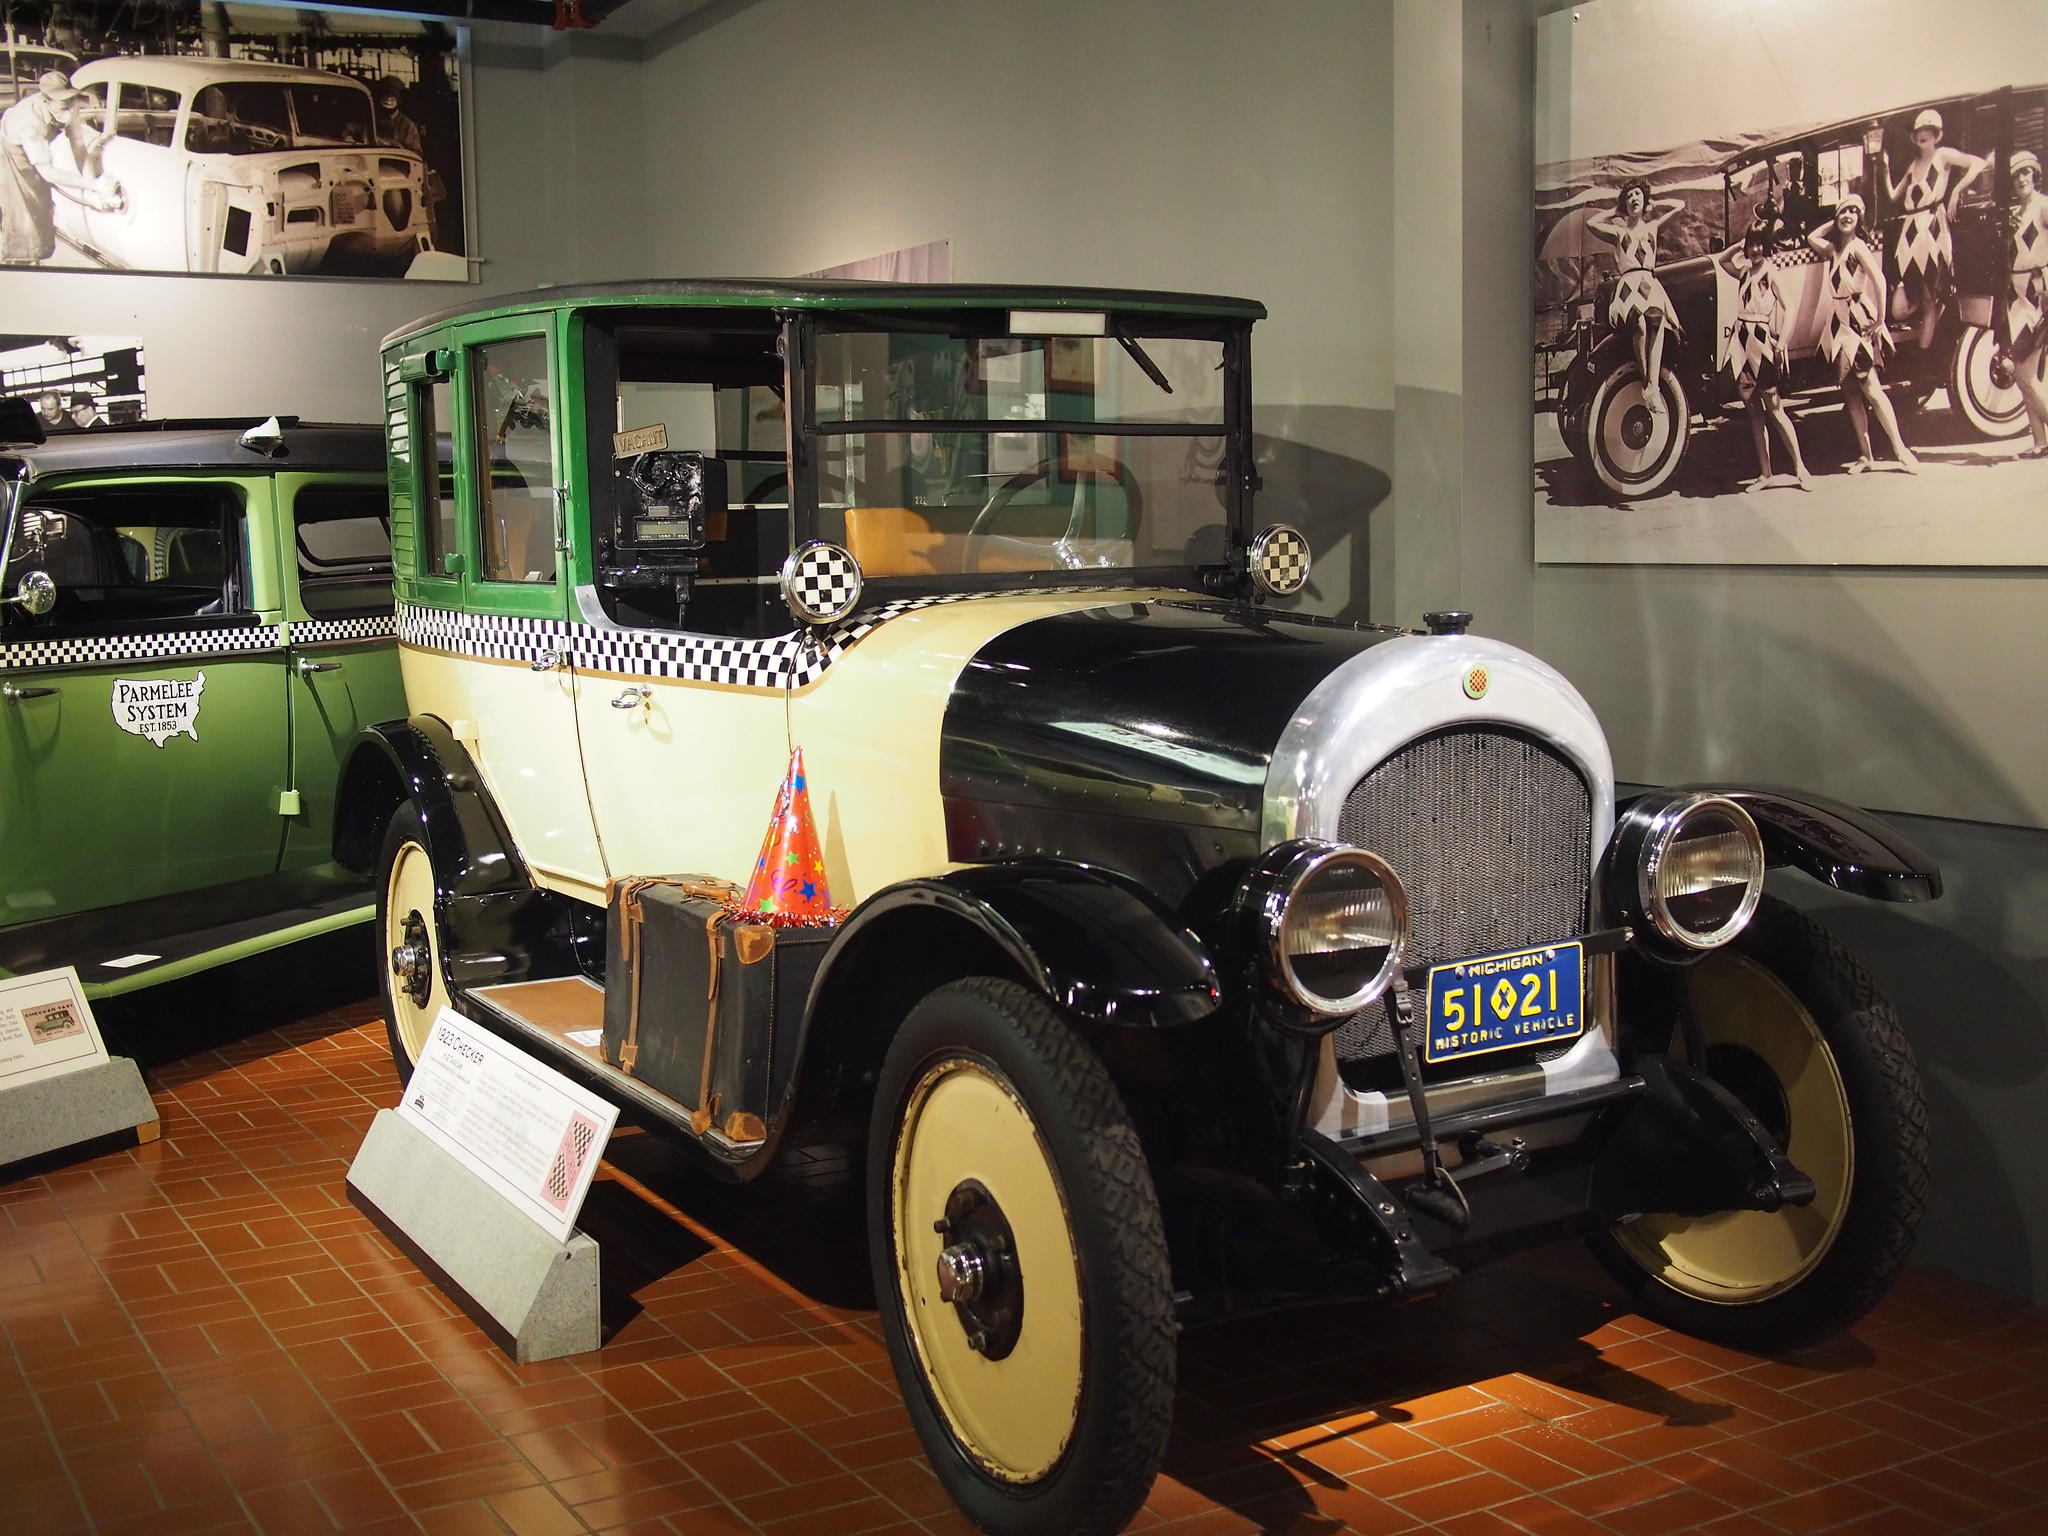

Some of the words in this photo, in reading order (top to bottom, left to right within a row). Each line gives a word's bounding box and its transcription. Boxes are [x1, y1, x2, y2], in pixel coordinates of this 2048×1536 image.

[618, 429, 664, 452] VACANT
[119, 682, 194, 704] PARMELEE
[128, 702, 188, 723] SYSTEM
[1468, 954, 1543, 978] MICHIGAN
[1435, 1027, 1504, 1051] HISTORIC
[1514, 1014, 1575, 1036] VEHICLE
[437, 1027, 455, 1047] 1923
[452, 1037, 485, 1067] CHECKER
